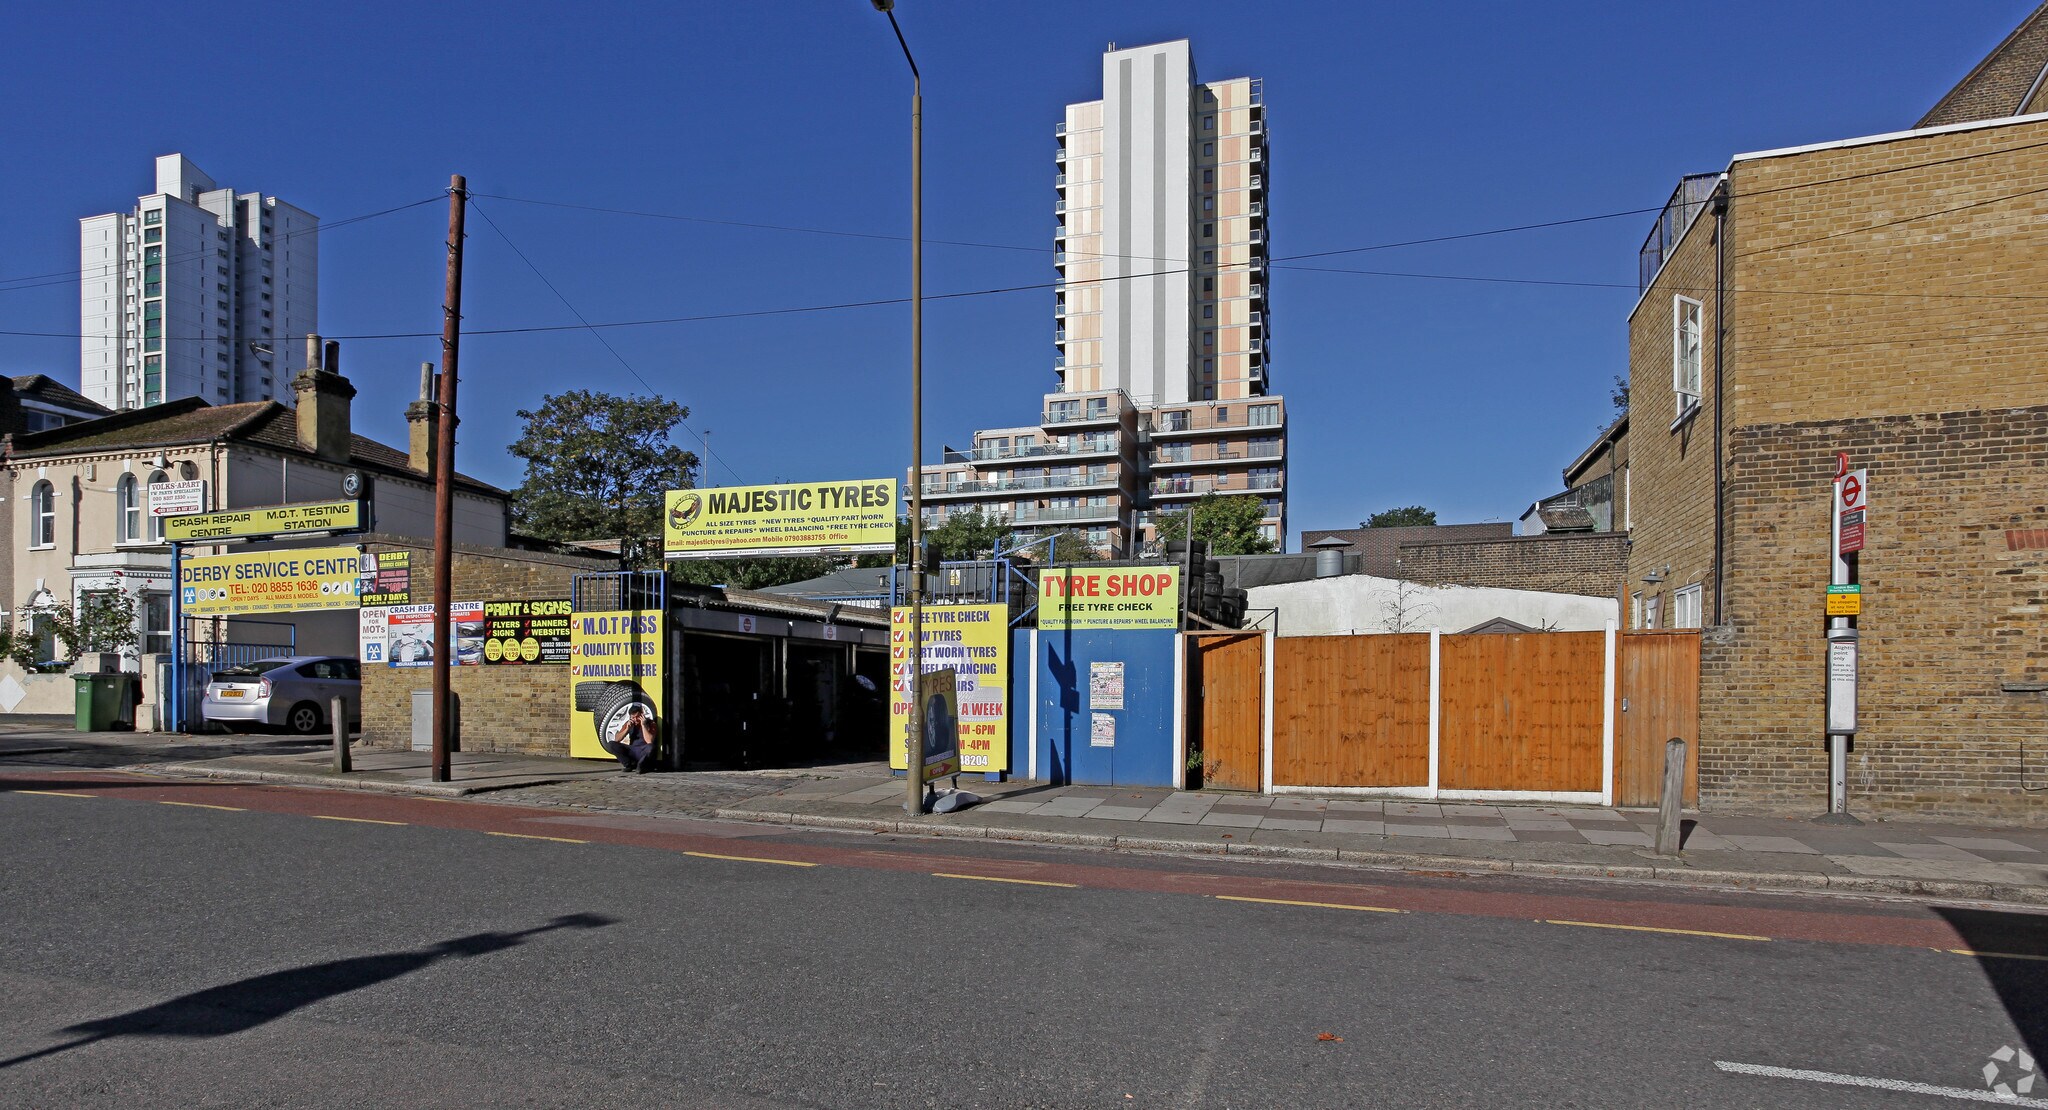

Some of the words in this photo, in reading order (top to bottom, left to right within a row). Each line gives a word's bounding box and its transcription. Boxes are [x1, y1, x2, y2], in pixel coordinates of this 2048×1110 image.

[709, 488, 811, 514] MAJESTIC
[818, 484, 890, 509] TYRES
[266, 509, 299, 520] M.O.T.
[302, 504, 350, 516] TESTING
[172, 516, 209, 528] CRASH
[212, 513, 251, 524] REPAIR
[284, 518, 332, 530] STATION
[190, 526, 232, 538] CENTRE
[681, 529, 717, 537] PUNCTURE
[784, 524, 825, 533] BALANCING
[379, 551, 410, 561] DERBY
[183, 564, 231, 583] DERBY
[235, 560, 300, 580] SERVICE
[304, 557, 360, 576] CENTR
[229, 584, 250, 595] TEL:
[251, 582, 268, 593] 020
[270, 581, 294, 593] 8855
[296, 580, 318, 592] 1636
[1043, 575, 1100, 598] TYRE
[1105, 573, 1173, 597] SHOP
[362, 594, 382, 603] OPEN
[382, 593, 388, 602] 7
[388, 592, 409, 601] DAYS
[389, 605, 416, 614] CRASH
[485, 602, 522, 617] PRINT
[523, 602, 530, 614] &
[530, 601, 573, 616] SIGNS
[1058, 603, 1085, 612] FREE
[1087, 603, 1115, 612] TYRE
[1116, 602, 1153, 611] CHECK
[362, 609, 386, 619] OPEN
[909, 612, 930, 624] FEE
[932, 611, 956, 623] TYRE
[957, 610, 990, 623] CHECK
[492, 620, 521, 629] FLYERS
[531, 619, 569, 627] BANNERS
[583, 616, 619, 636] M.O.T
[621, 615, 657, 635] PASS
[1149, 617, 1174, 625] BALANCING
[362, 625, 386, 634] MOTs
[492, 629, 516, 637] SIGNS
[531, 628, 571, 636] WEBSITES
[908, 630, 930, 642] NW
[932, 629, 962, 642] TYRES
[582, 642, 622, 658] QUALITY
[623, 641, 655, 656] TYRES
[908, 647, 933, 658] PRT
[934, 646, 965, 658] WORN
[966, 646, 997, 658] TYRES
[582, 663, 631, 677] AVAILABLE
[633, 663, 657, 677] HERE
[893, 702, 914, 715] OPE
[961, 702, 969, 716] A
[971, 702, 1003, 716] WEEK
